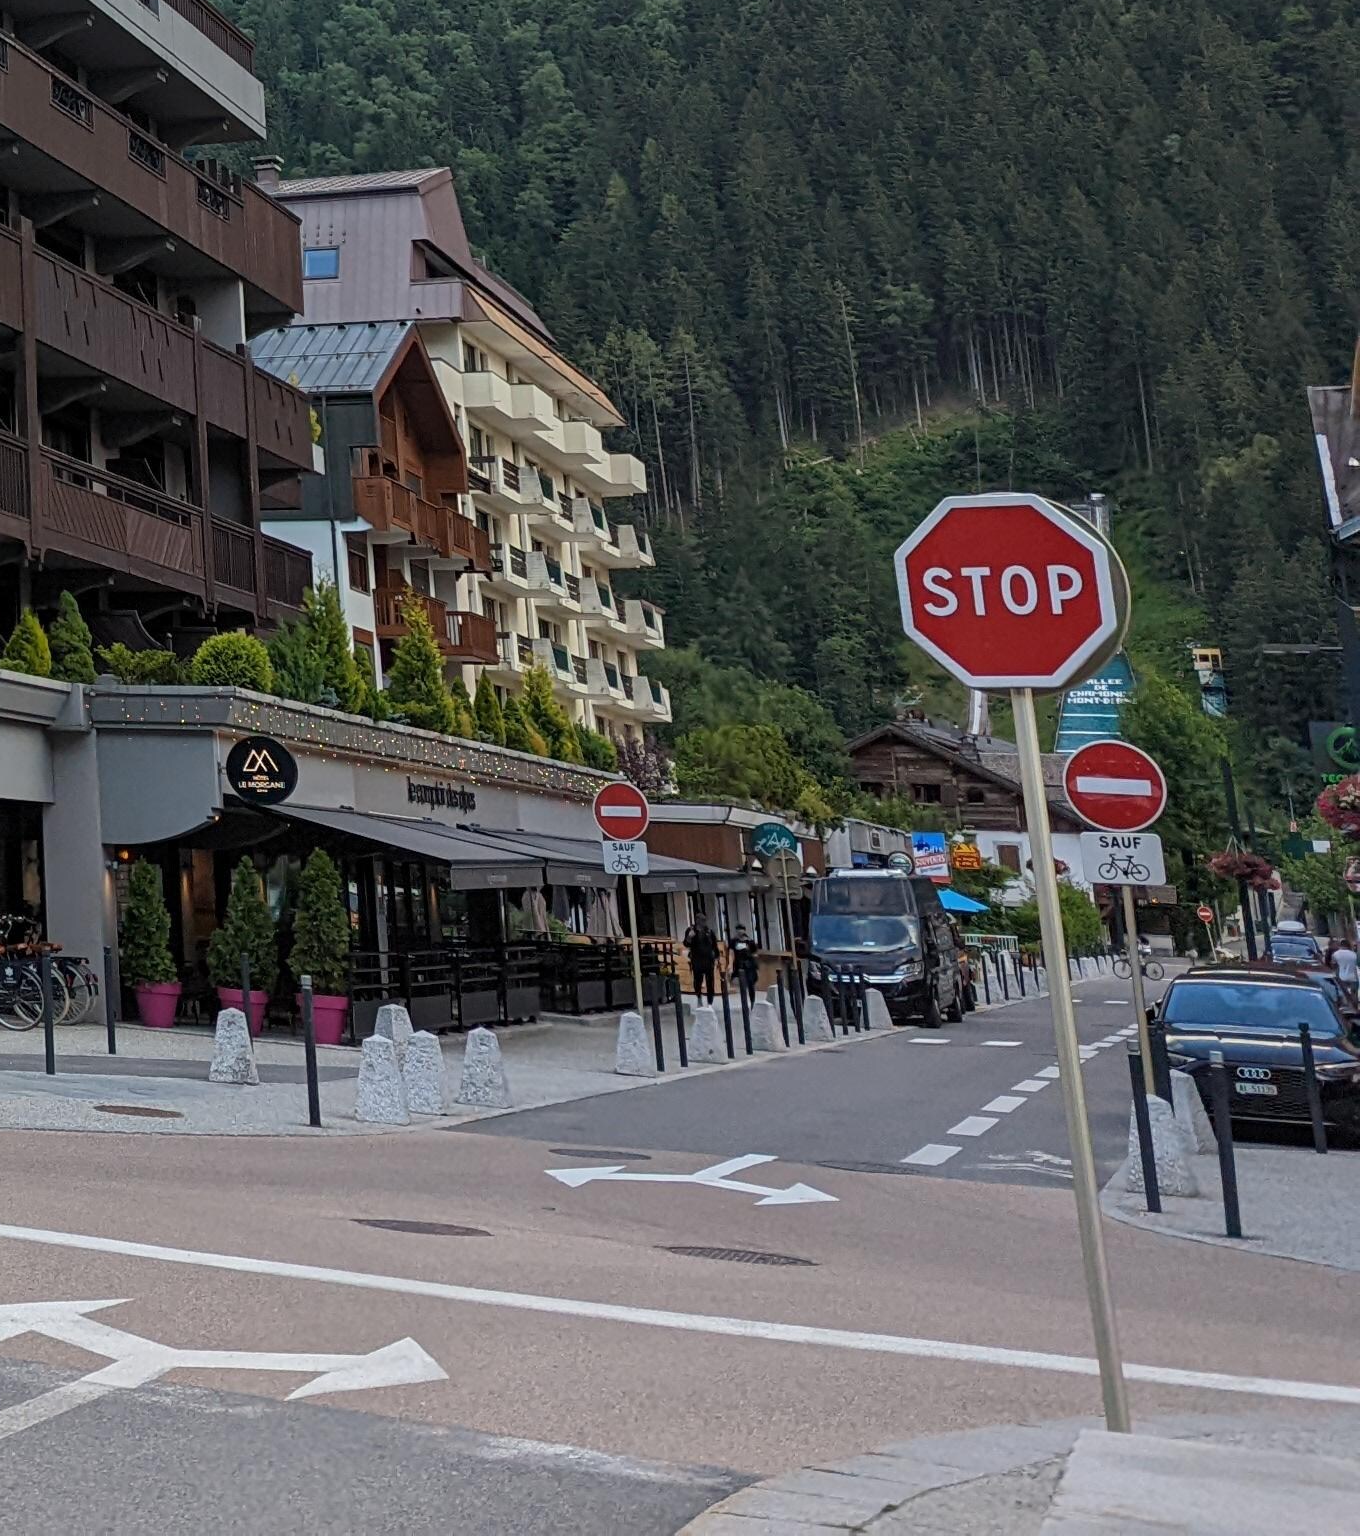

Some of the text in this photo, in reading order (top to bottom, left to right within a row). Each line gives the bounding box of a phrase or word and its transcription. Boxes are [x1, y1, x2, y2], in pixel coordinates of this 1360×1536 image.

[922, 564, 1083, 617] STOP
[611, 842, 636, 852] SAUF
[1099, 835, 1142, 849] SAUF
